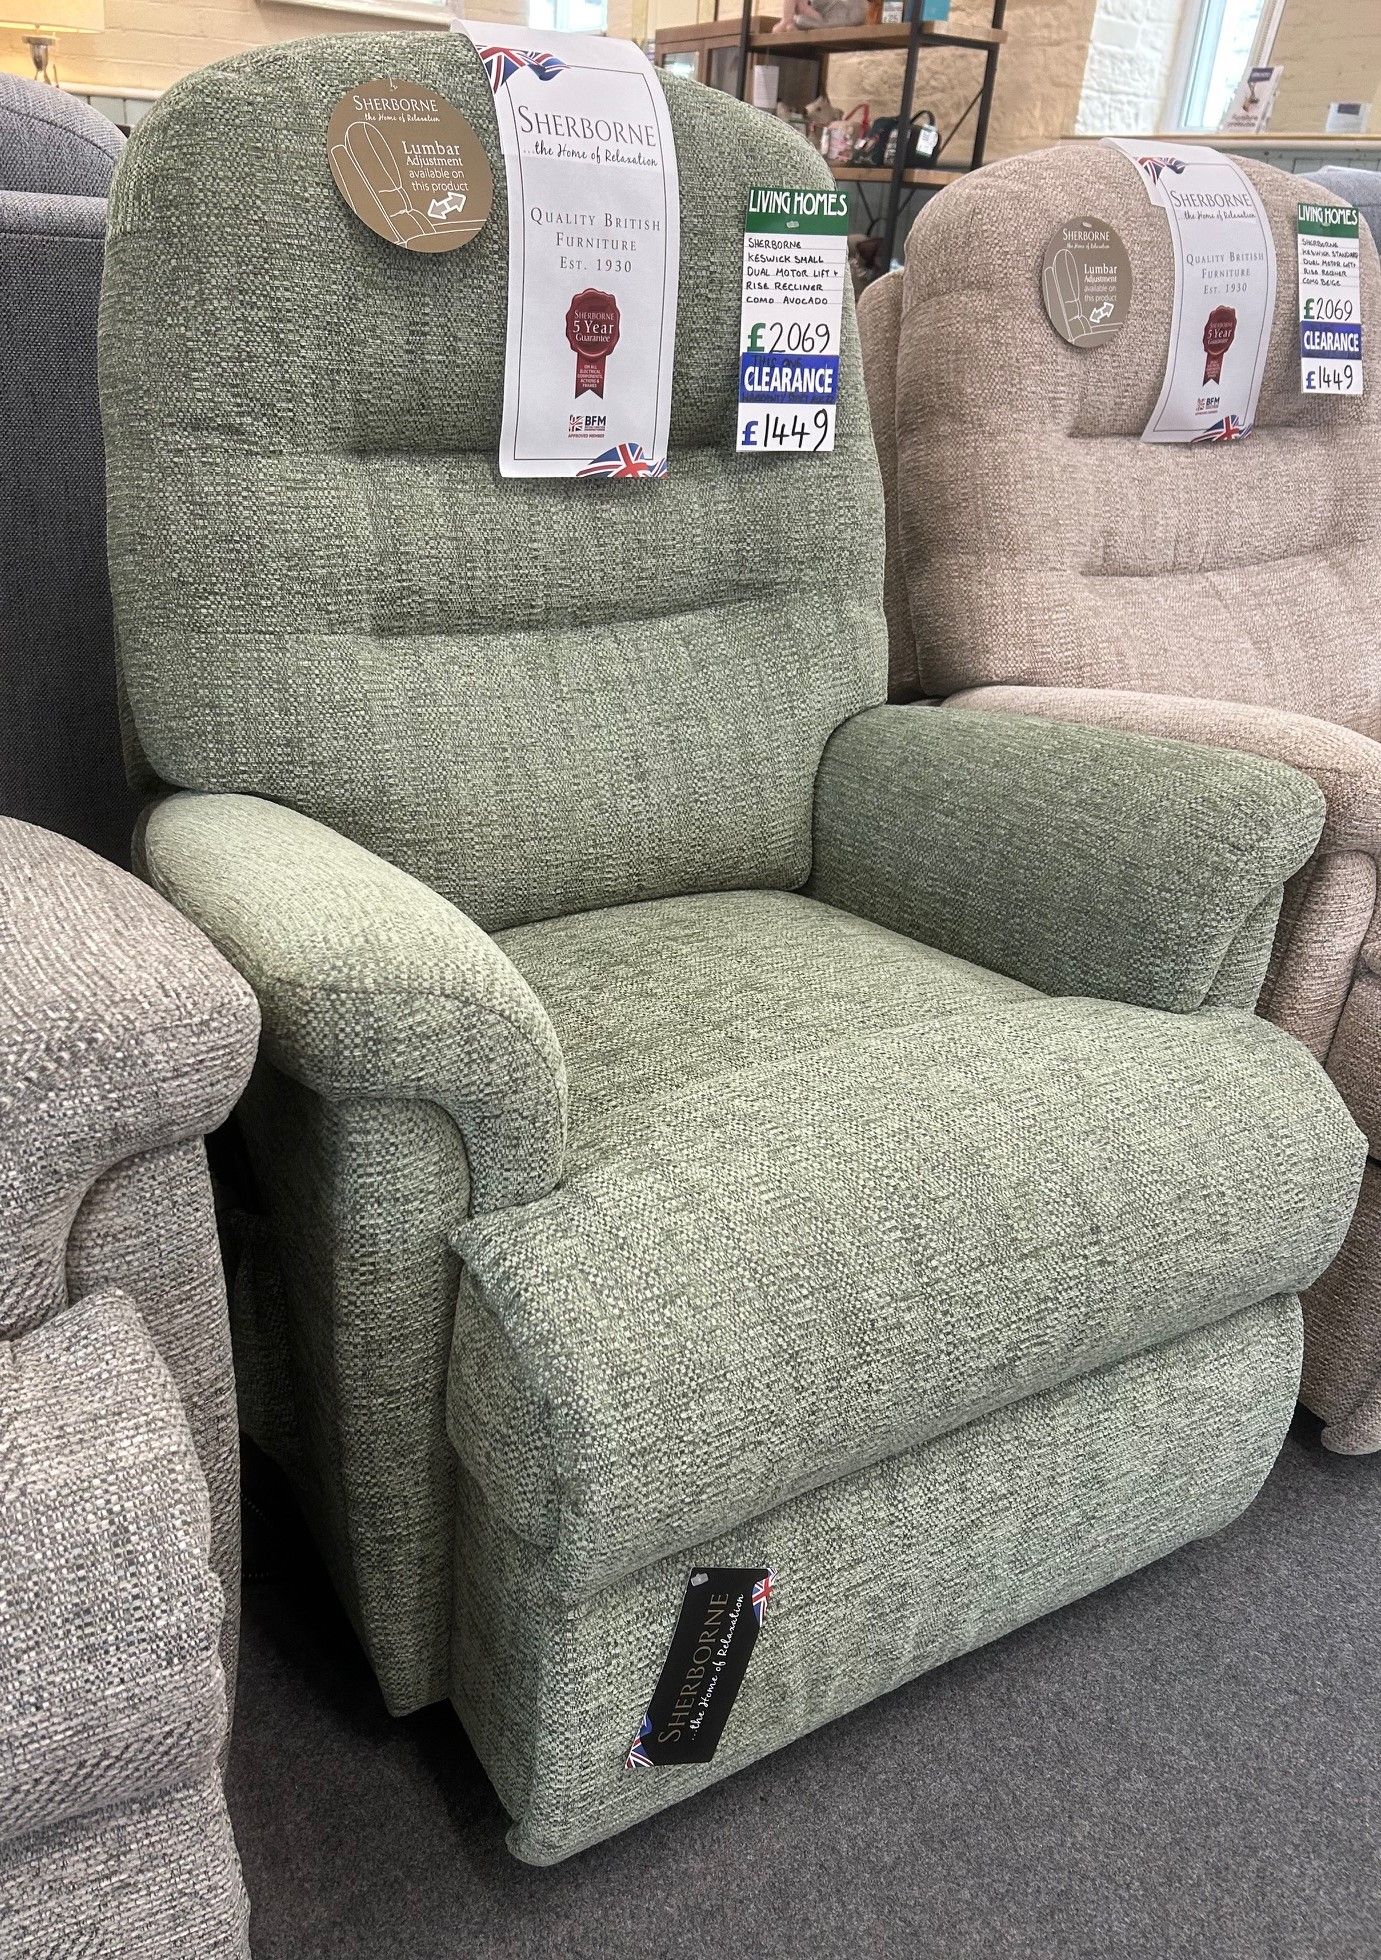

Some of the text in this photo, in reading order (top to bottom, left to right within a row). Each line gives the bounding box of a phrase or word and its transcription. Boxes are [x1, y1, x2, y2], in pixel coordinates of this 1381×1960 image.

[353, 95, 438, 112] SHERBORNE
[518, 105, 656, 147] SHERBORNE
[402, 140, 460, 155] Lumbar
[558, 143, 587, 159] Home
[591, 146, 601, 164] of
[605, 149, 659, 167] Relaxation
[406, 155, 463, 168] Adjustment
[409, 168, 465, 179] available on
[412, 181, 469, 193] this product
[748, 189, 848, 216] LIVING HOMES
[1170, 190, 1252, 208] SHERBORNE
[531, 207, 661, 231] QUALITY BRITISH
[1298, 204, 1358, 226] LIVING HOMES
[556, 232, 637, 251] FURNITURE
[1063, 228, 1110, 241] SHERBORNE
[748, 238, 802, 250] SHERBORNE
[560, 256, 632, 273] EST. 1930
[748, 252, 824, 264] KESWICK SMALL
[1186, 251, 1264, 266] QUALITY BRITISH
[747, 266, 770, 277] DUAL
[776, 268, 808, 278] MOTOR
[1084, 263, 1118, 274] Lumbar
[1202, 268, 1251, 279] FURNITURE
[746, 280, 824, 292] RISE RECLINER
[1225, 282, 1248, 293] 1930
[746, 296, 828, 305] COMO AVOCADO
[574, 310, 615, 321] SHERBORNE
[1304, 297, 1353, 321] £2069
[573, 320, 615, 334] 5 Year
[1207, 328, 1232, 339] 5 Year
[575, 333, 611, 343] Guarantee
[747, 322, 831, 354] £2069
[1303, 330, 1360, 352] CLEARANCE
[744, 366, 834, 394] CLEARANCE
[1306, 364, 1353, 390] £1449
[585, 415, 607, 426] BFM
[741, 408, 828, 452] £1449
[717, 1593, 744, 1657] Relaxation
[658, 1593, 729, 1743] SHERBORNE
[712, 1660, 726, 1672] of
[698, 1675, 718, 1708] Home
